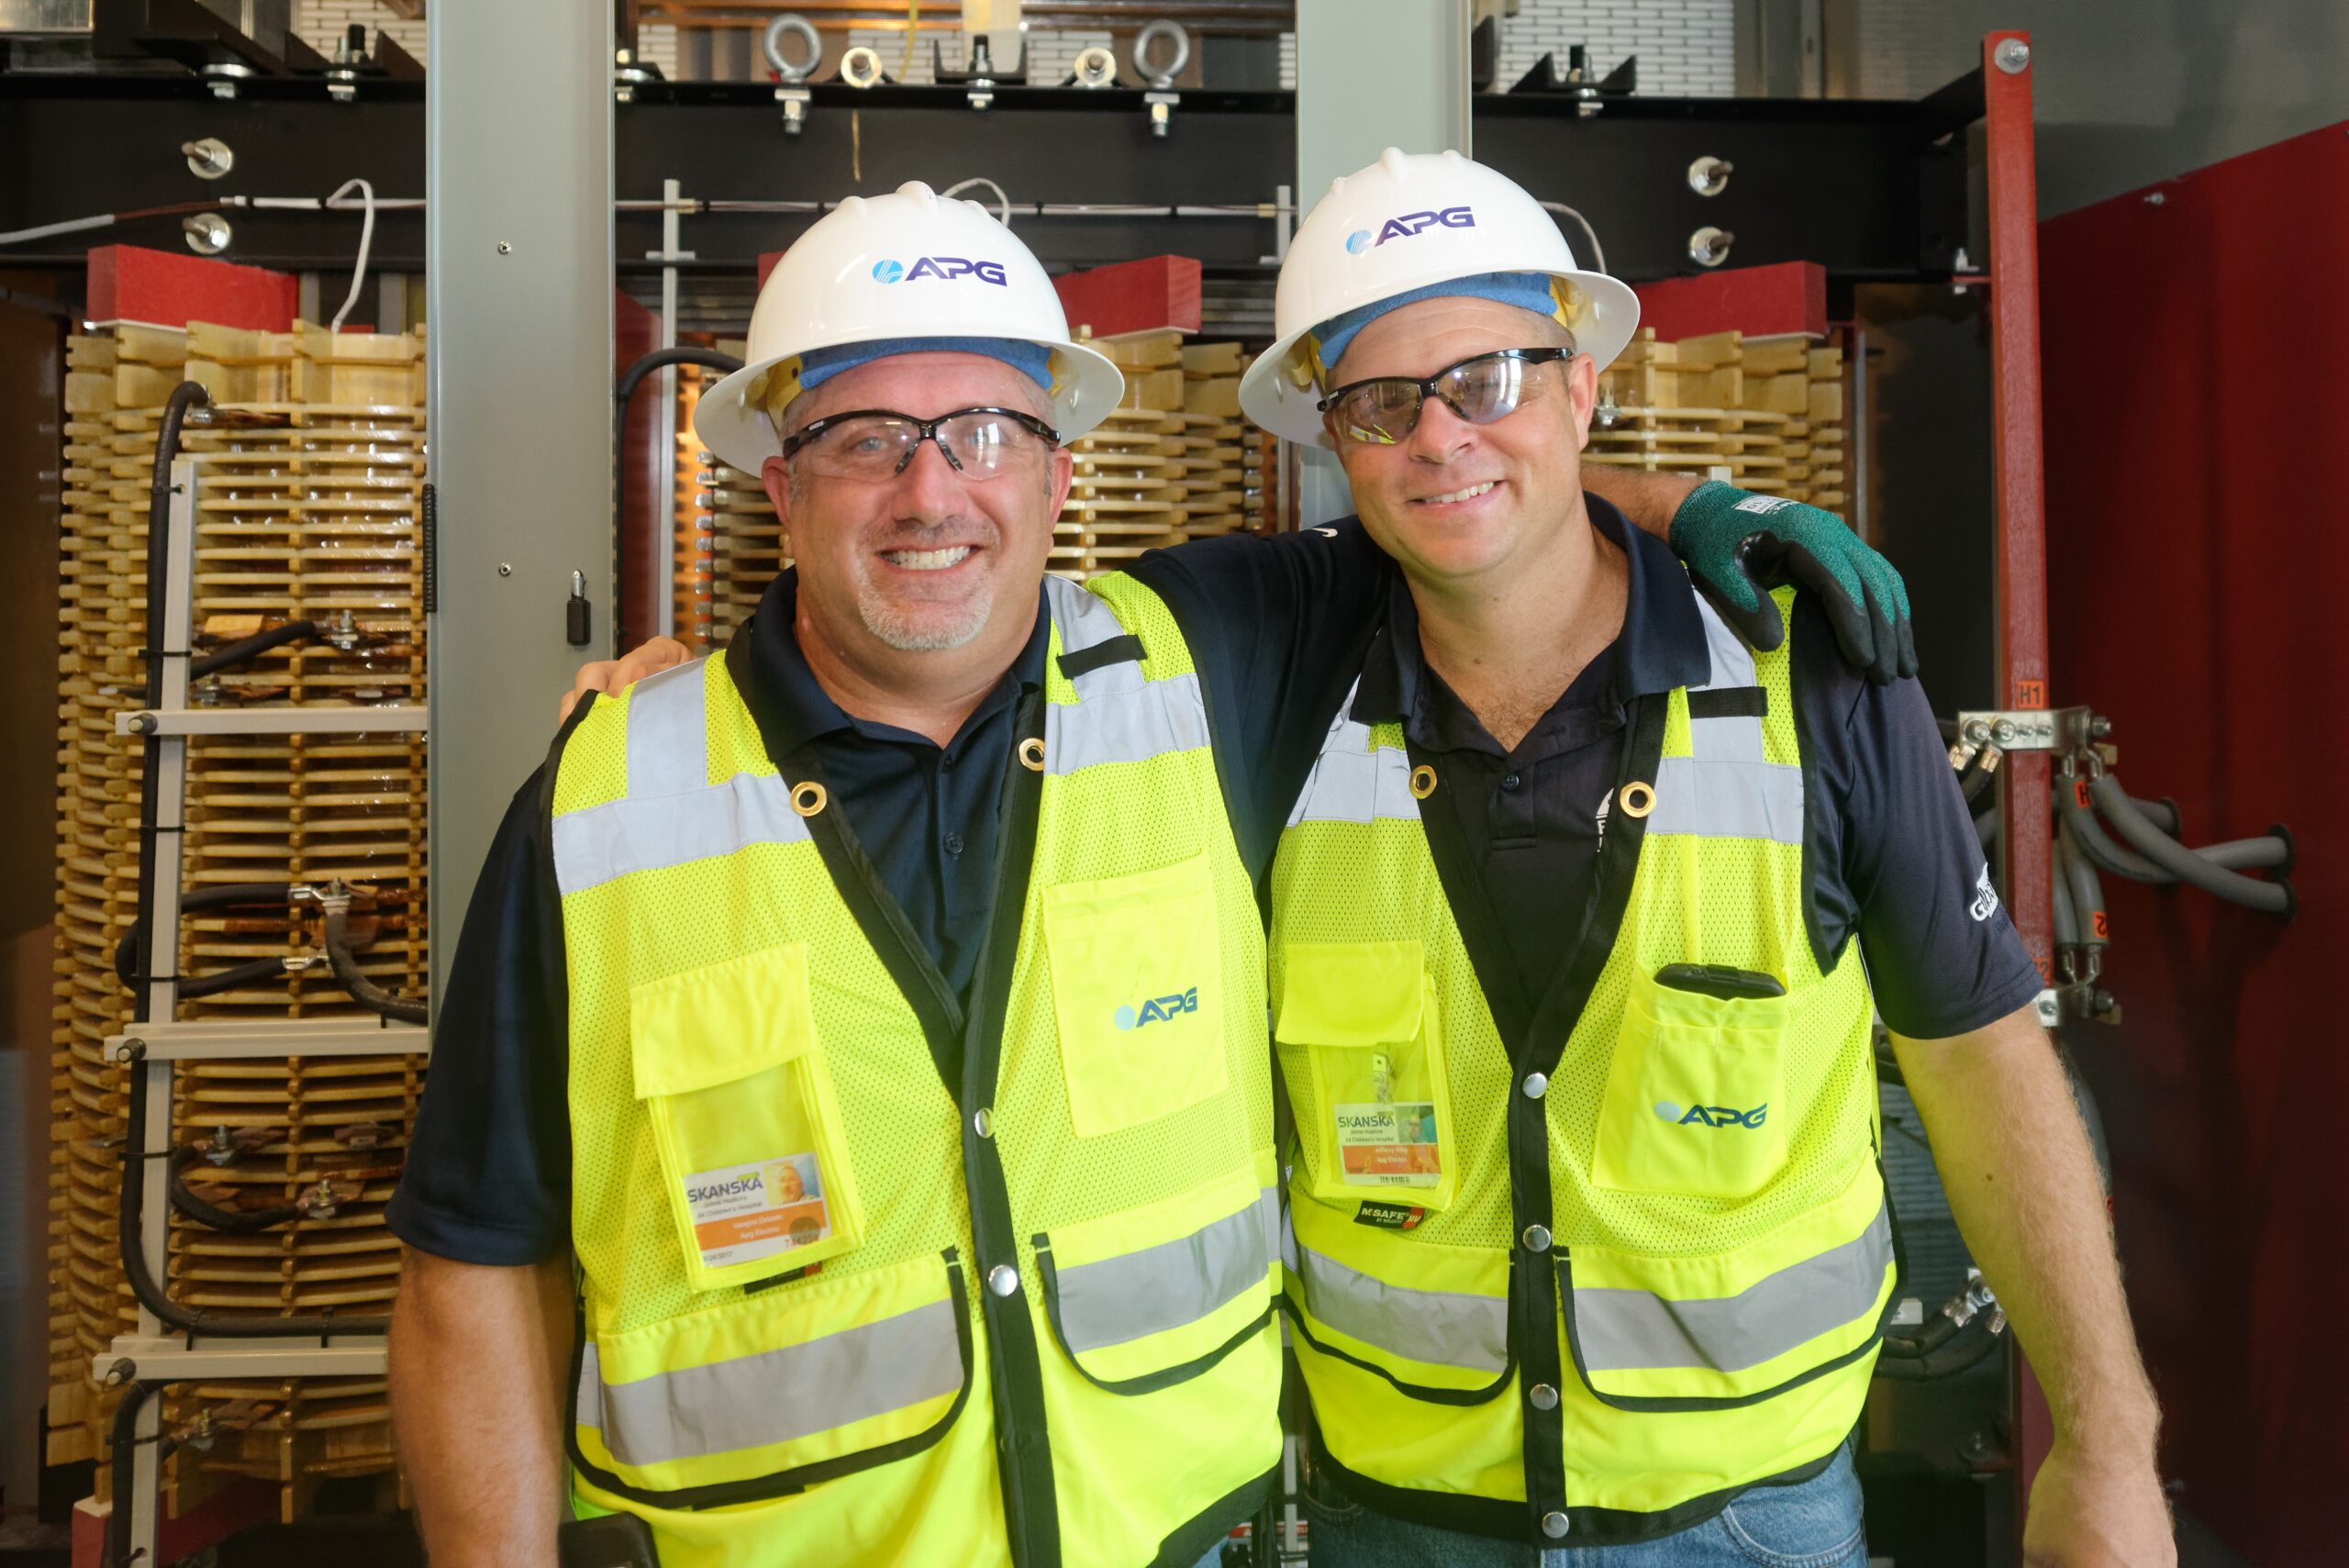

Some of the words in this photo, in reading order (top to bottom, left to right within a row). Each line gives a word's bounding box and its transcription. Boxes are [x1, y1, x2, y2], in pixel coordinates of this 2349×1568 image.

[1375, 206, 1475, 248] APG
[905, 257, 1008, 287] APG
[2020, 684, 2041, 705] H1
[1136, 986, 1197, 1028] APG
[1338, 1116, 1395, 1128] SKANSKA
[1677, 1103, 1767, 1129] APG
[687, 1176, 763, 1203] SKANSKA
